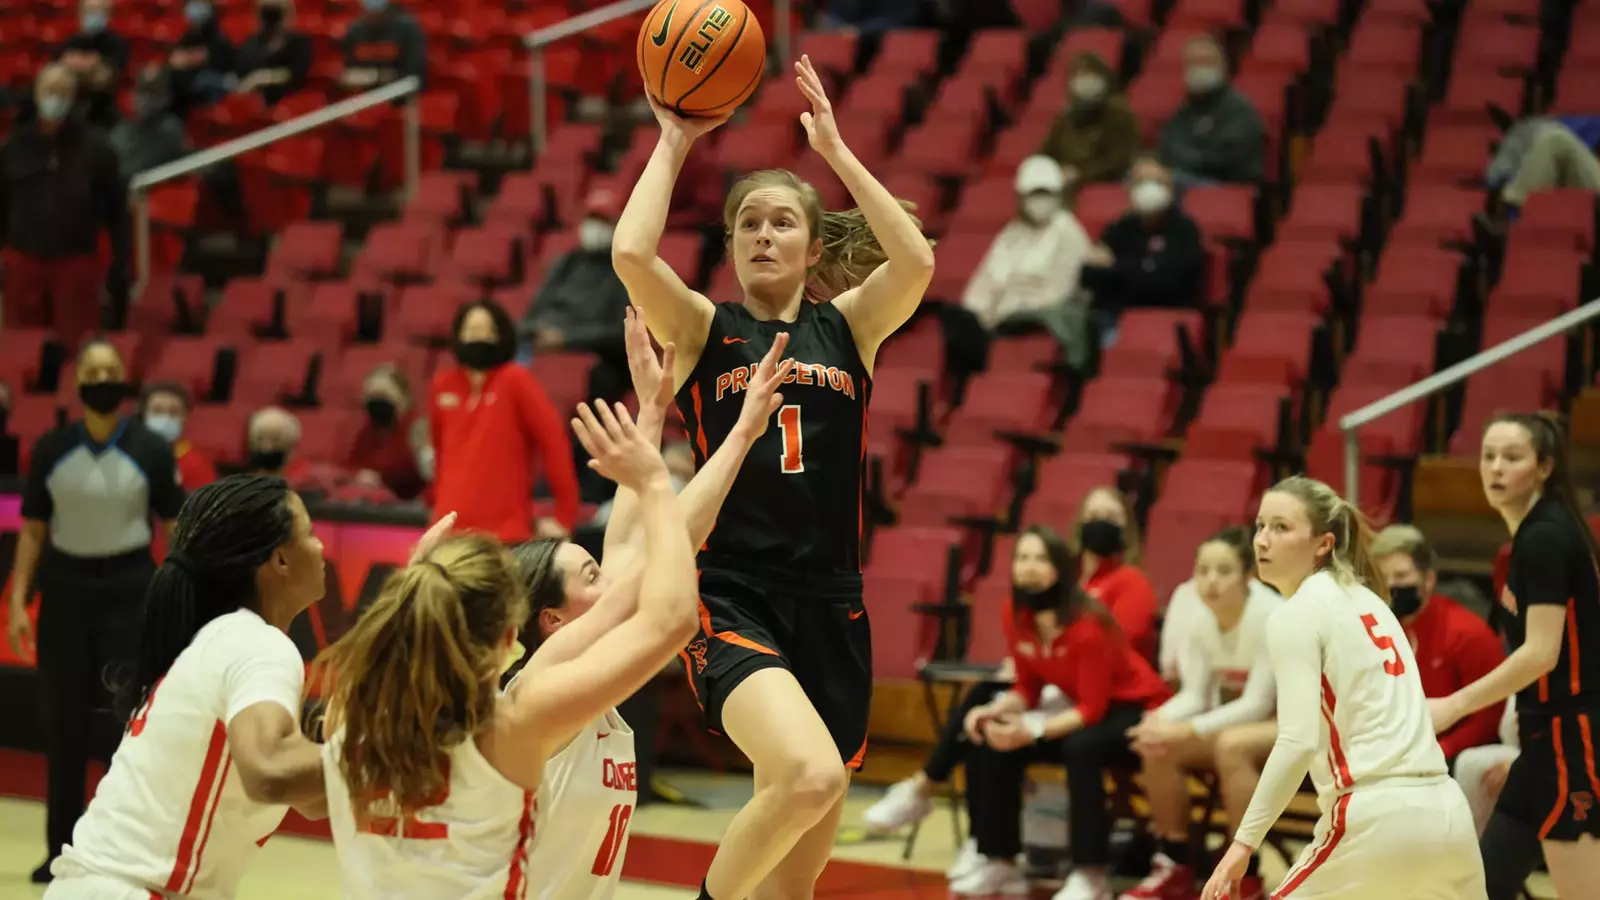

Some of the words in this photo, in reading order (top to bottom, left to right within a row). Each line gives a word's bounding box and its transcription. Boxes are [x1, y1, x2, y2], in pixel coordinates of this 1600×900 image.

[679, 5, 732, 71] ELITE
[716, 360, 855, 401] PRCETON
[778, 405, 804, 473] 1
[1360, 612, 1405, 676] 5
